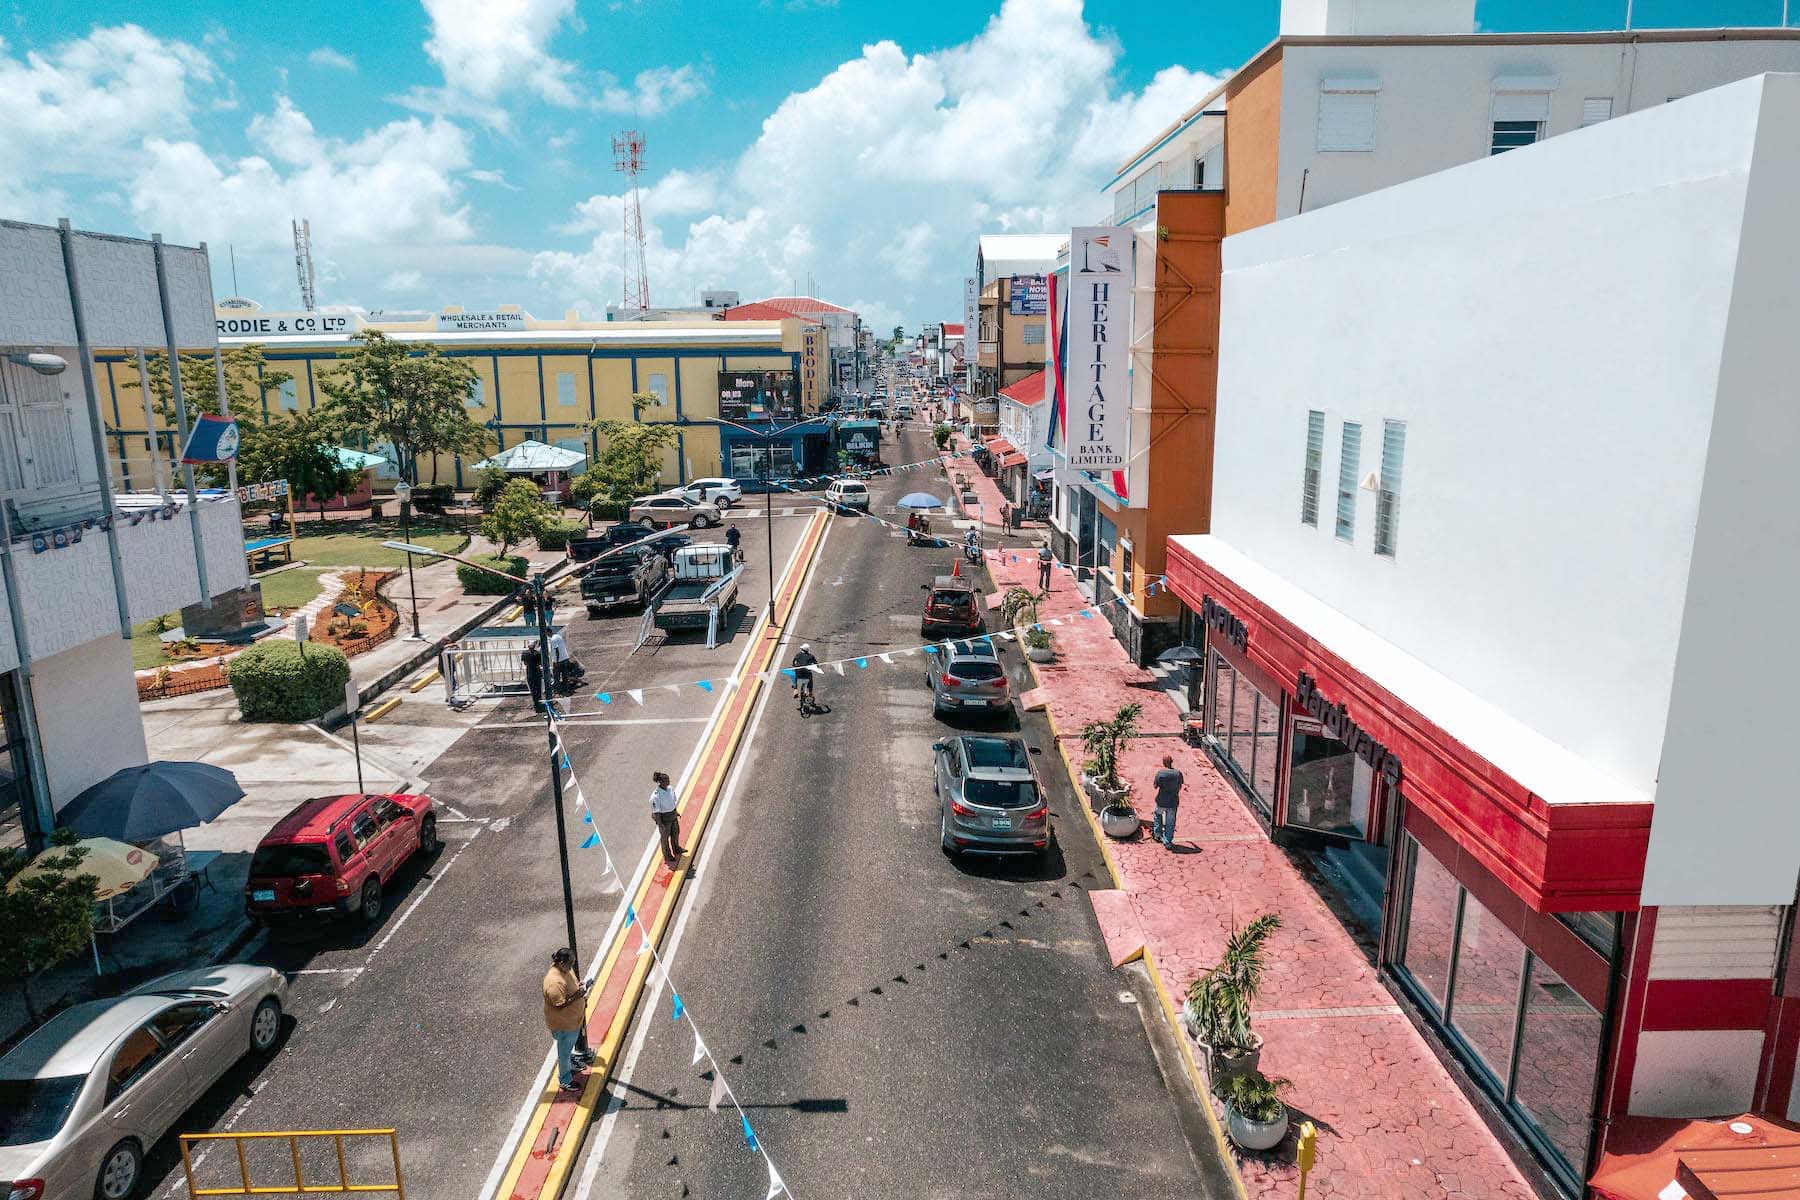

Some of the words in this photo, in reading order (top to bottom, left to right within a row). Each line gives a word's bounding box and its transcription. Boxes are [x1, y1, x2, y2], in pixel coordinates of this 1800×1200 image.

[496, 313, 523, 321] RETAIL
[216, 319, 271, 333] RODIE
[278, 320, 288, 332] &
[457, 321, 507, 329] MERCHANTS
[1088, 282, 1109, 442] HERITAGE
[805, 335, 816, 411] BRODIES
[735, 378, 755, 388] More
[846, 441, 874, 450] BELIKIN
[1079, 444, 1113, 455] BANK
[1070, 454, 1123, 466] LIMITED
[239, 479, 288, 503] BELIZE
